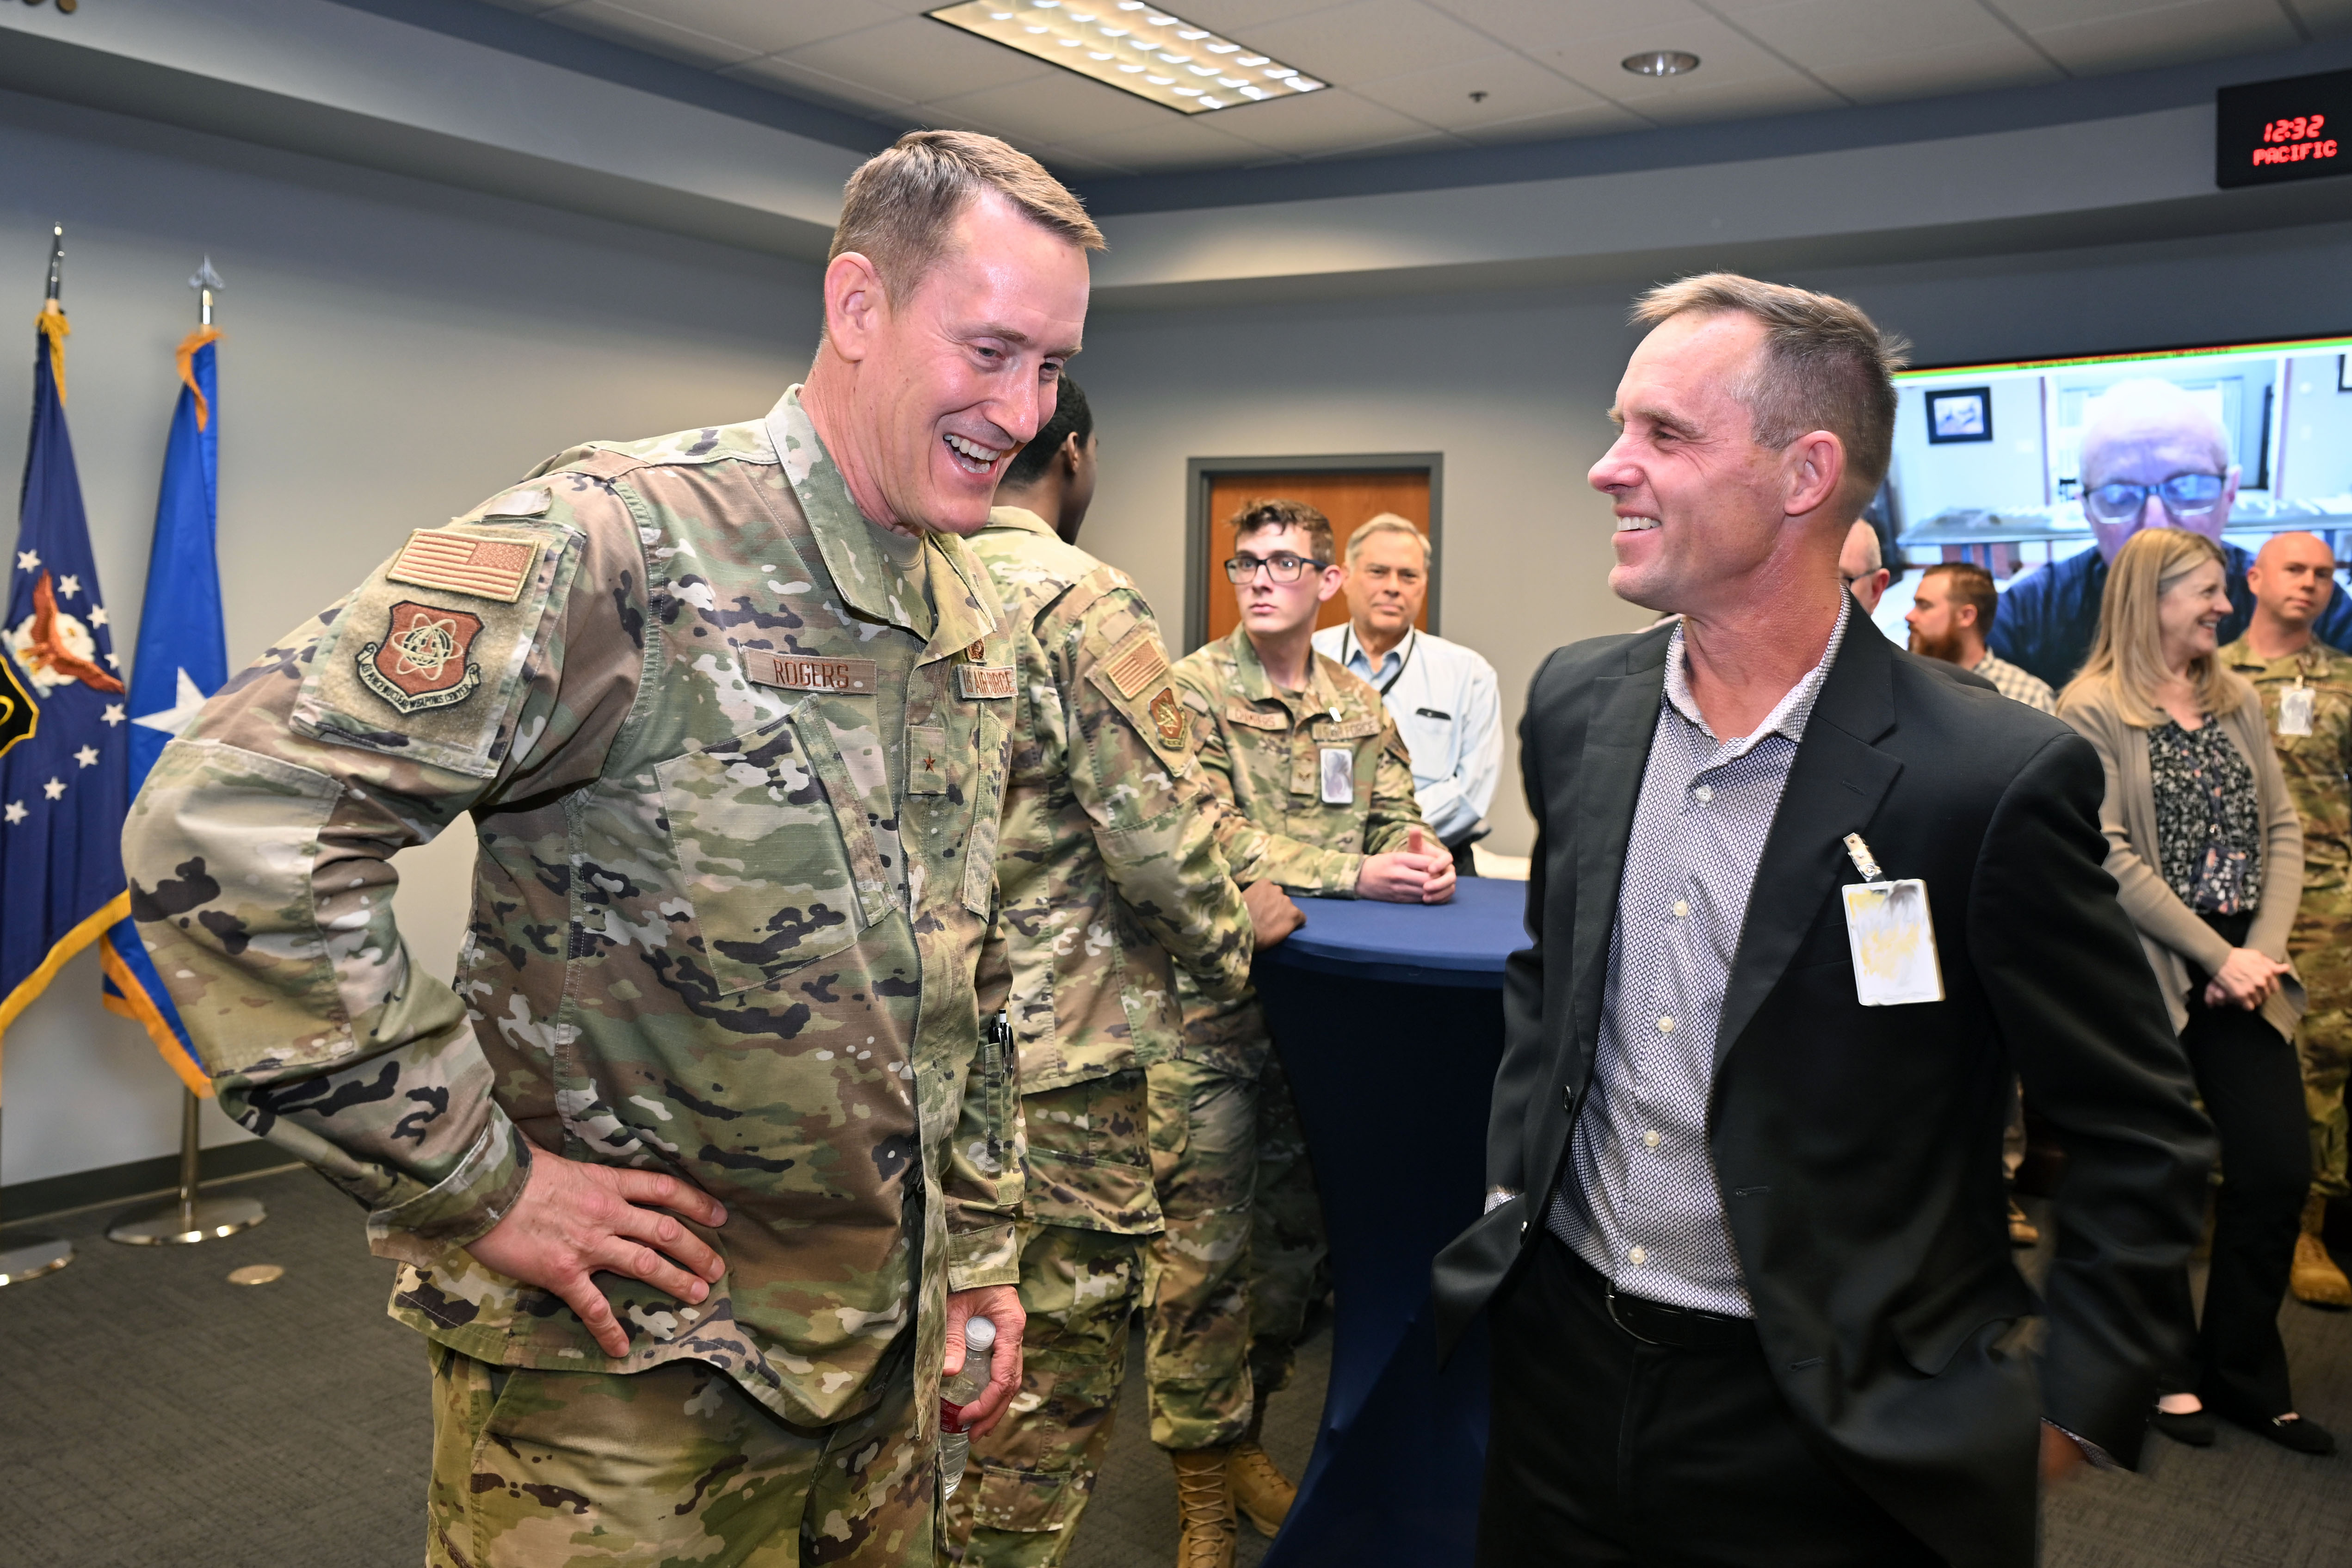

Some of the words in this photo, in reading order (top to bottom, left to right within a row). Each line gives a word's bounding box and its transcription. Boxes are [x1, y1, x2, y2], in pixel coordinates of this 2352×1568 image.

[2263, 114, 2325, 142] 12:32
[2253, 140, 2337, 166] PACIFIC
[773, 659, 849, 688] ROGERS
[974, 670, 989, 693] AIR
[987, 669, 1015, 693] FORCE
[409, 695, 444, 708] WEAPONS
